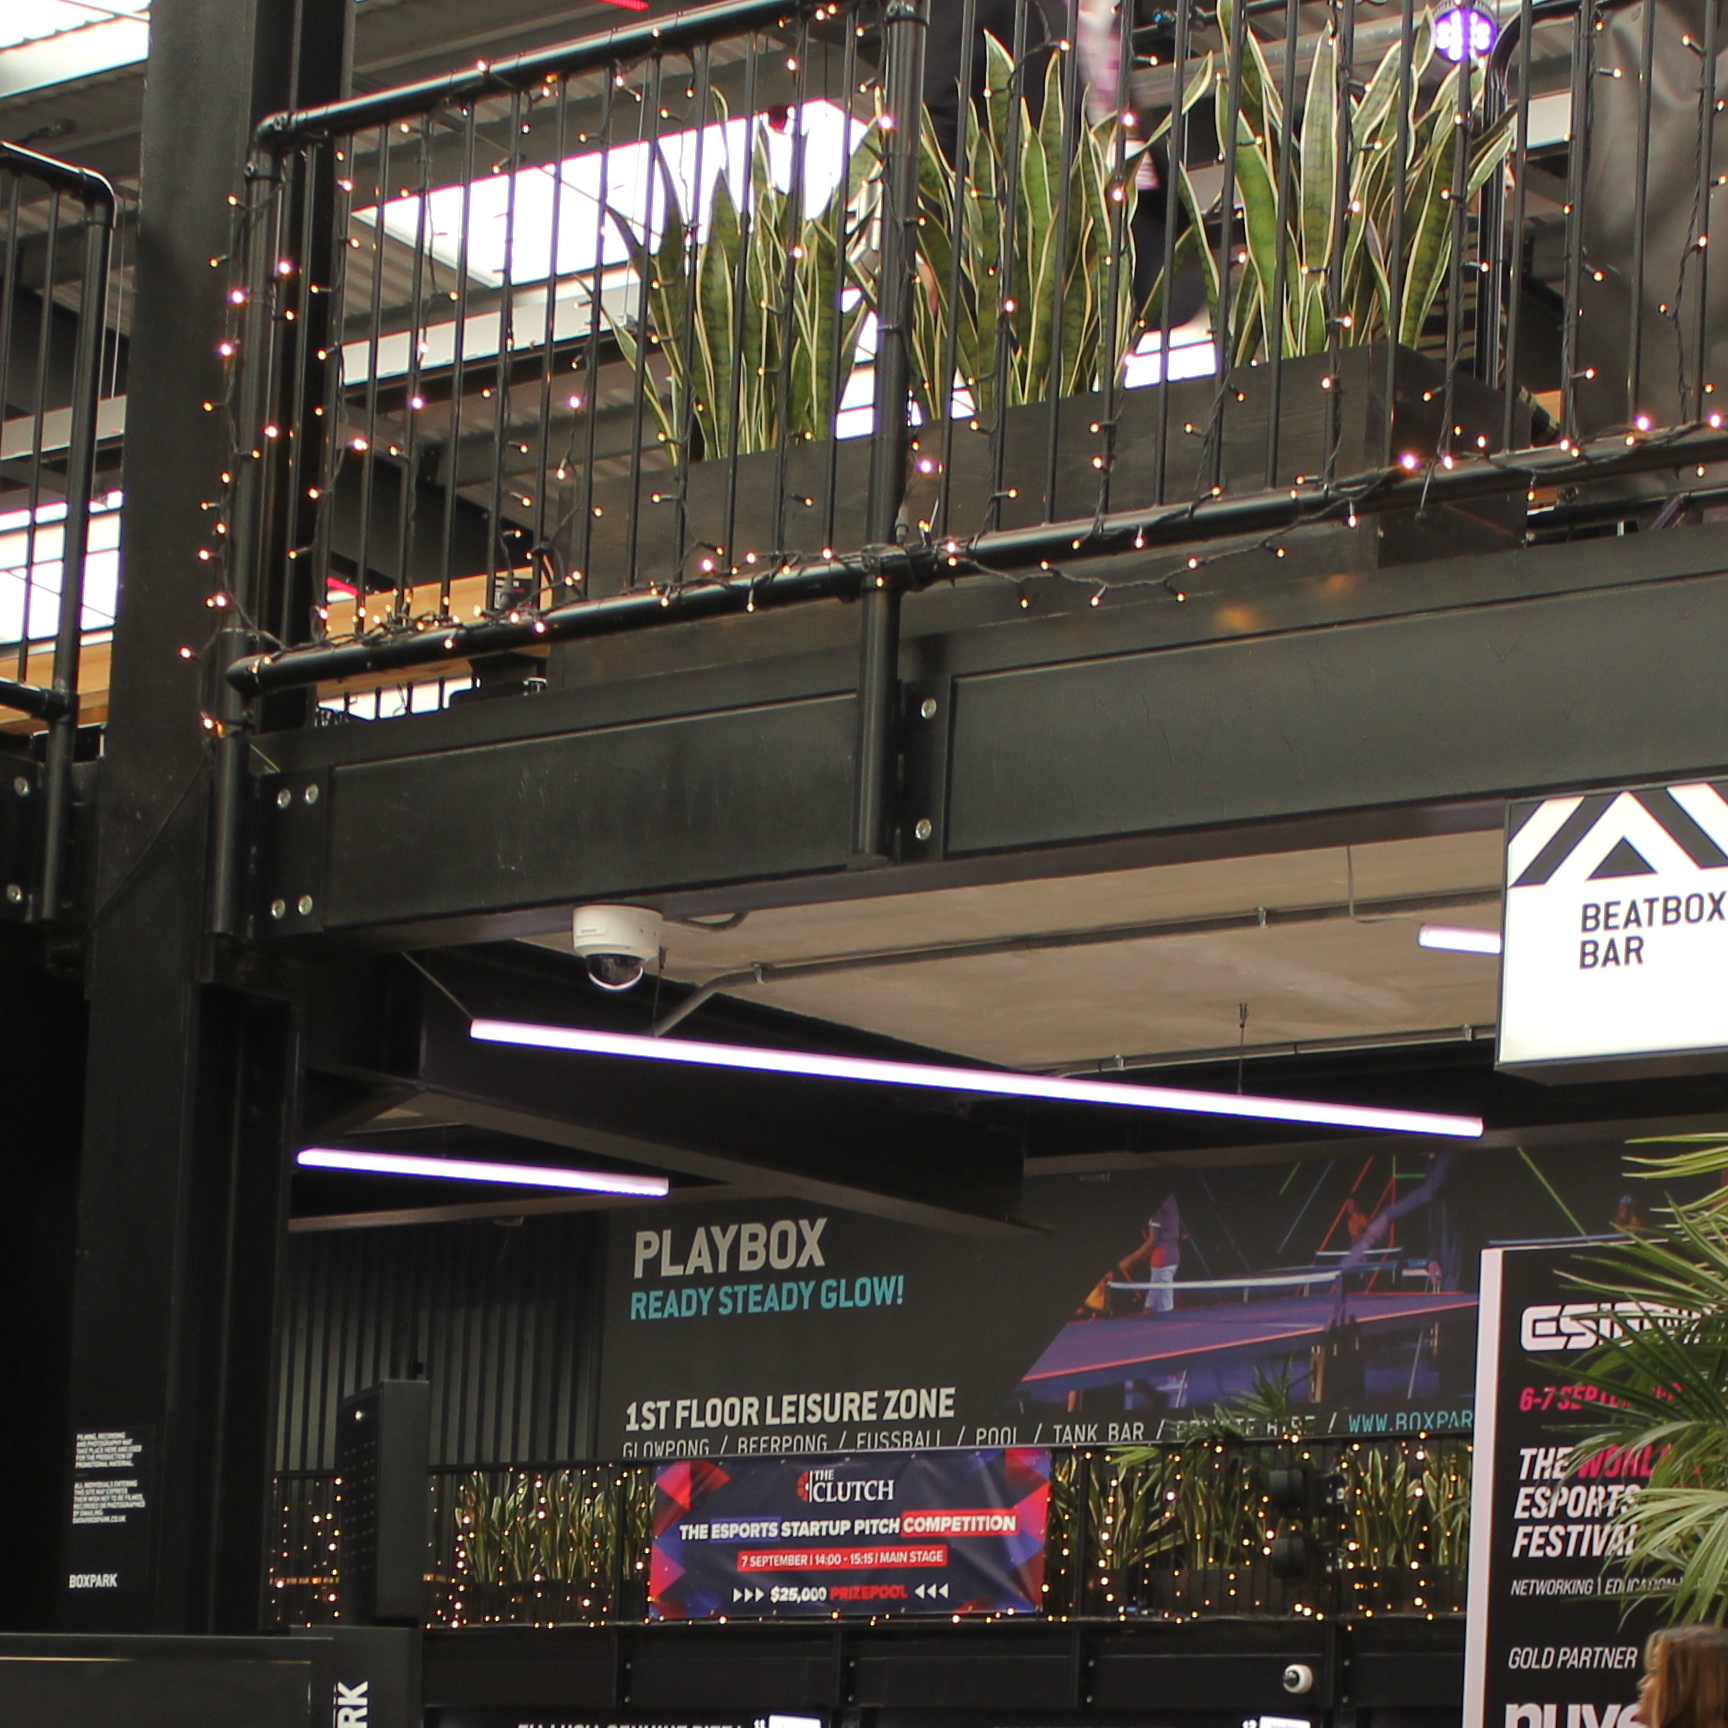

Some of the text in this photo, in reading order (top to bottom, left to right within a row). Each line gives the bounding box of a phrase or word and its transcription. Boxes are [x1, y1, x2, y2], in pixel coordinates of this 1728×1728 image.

[1580, 890, 1727, 933] BEATBOX
[1579, 935, 1645, 970] BAR
[634, 1218, 828, 1278] PLAYBOX
[630, 1275, 905, 1320] READY STEADY GLOW!
[625, 1387, 956, 1431] 1ST FLOOR LEISURE ZONE
[1519, 1386, 1556, 1411] 6-7
[975, 1425, 1019, 1446] POOL
[1053, 1423, 1100, 1444] TANK
[1107, 1422, 1144, 1442] BAR
[1519, 1444, 1676, 1480] THE WORL
[814, 1470, 834, 1481] THE
[812, 1480, 894, 1503] CLUTCH
[1514, 1484, 1643, 1520] ESPORTS
[679, 1515, 1017, 1540] THE ESPORTS STARTUP PITCH COMPETITION
[1512, 1524, 1642, 1558] FESTIVAL
[741, 1557, 748, 1568] 7
[749, 1553, 807, 1568] SEPTEMBER
[815, 1552, 842, 1566] 14:00
[879, 1551, 908, 1564] MAIN
[909, 1550, 943, 1564] STAGE
[69, 1573, 118, 1588] BOXPARK
[1511, 1578, 1593, 1596] NETWORKING
[770, 1585, 908, 1603] $25,000 PRIZEPOOL
[1508, 1647, 1638, 1669] GOLD PARTNER
